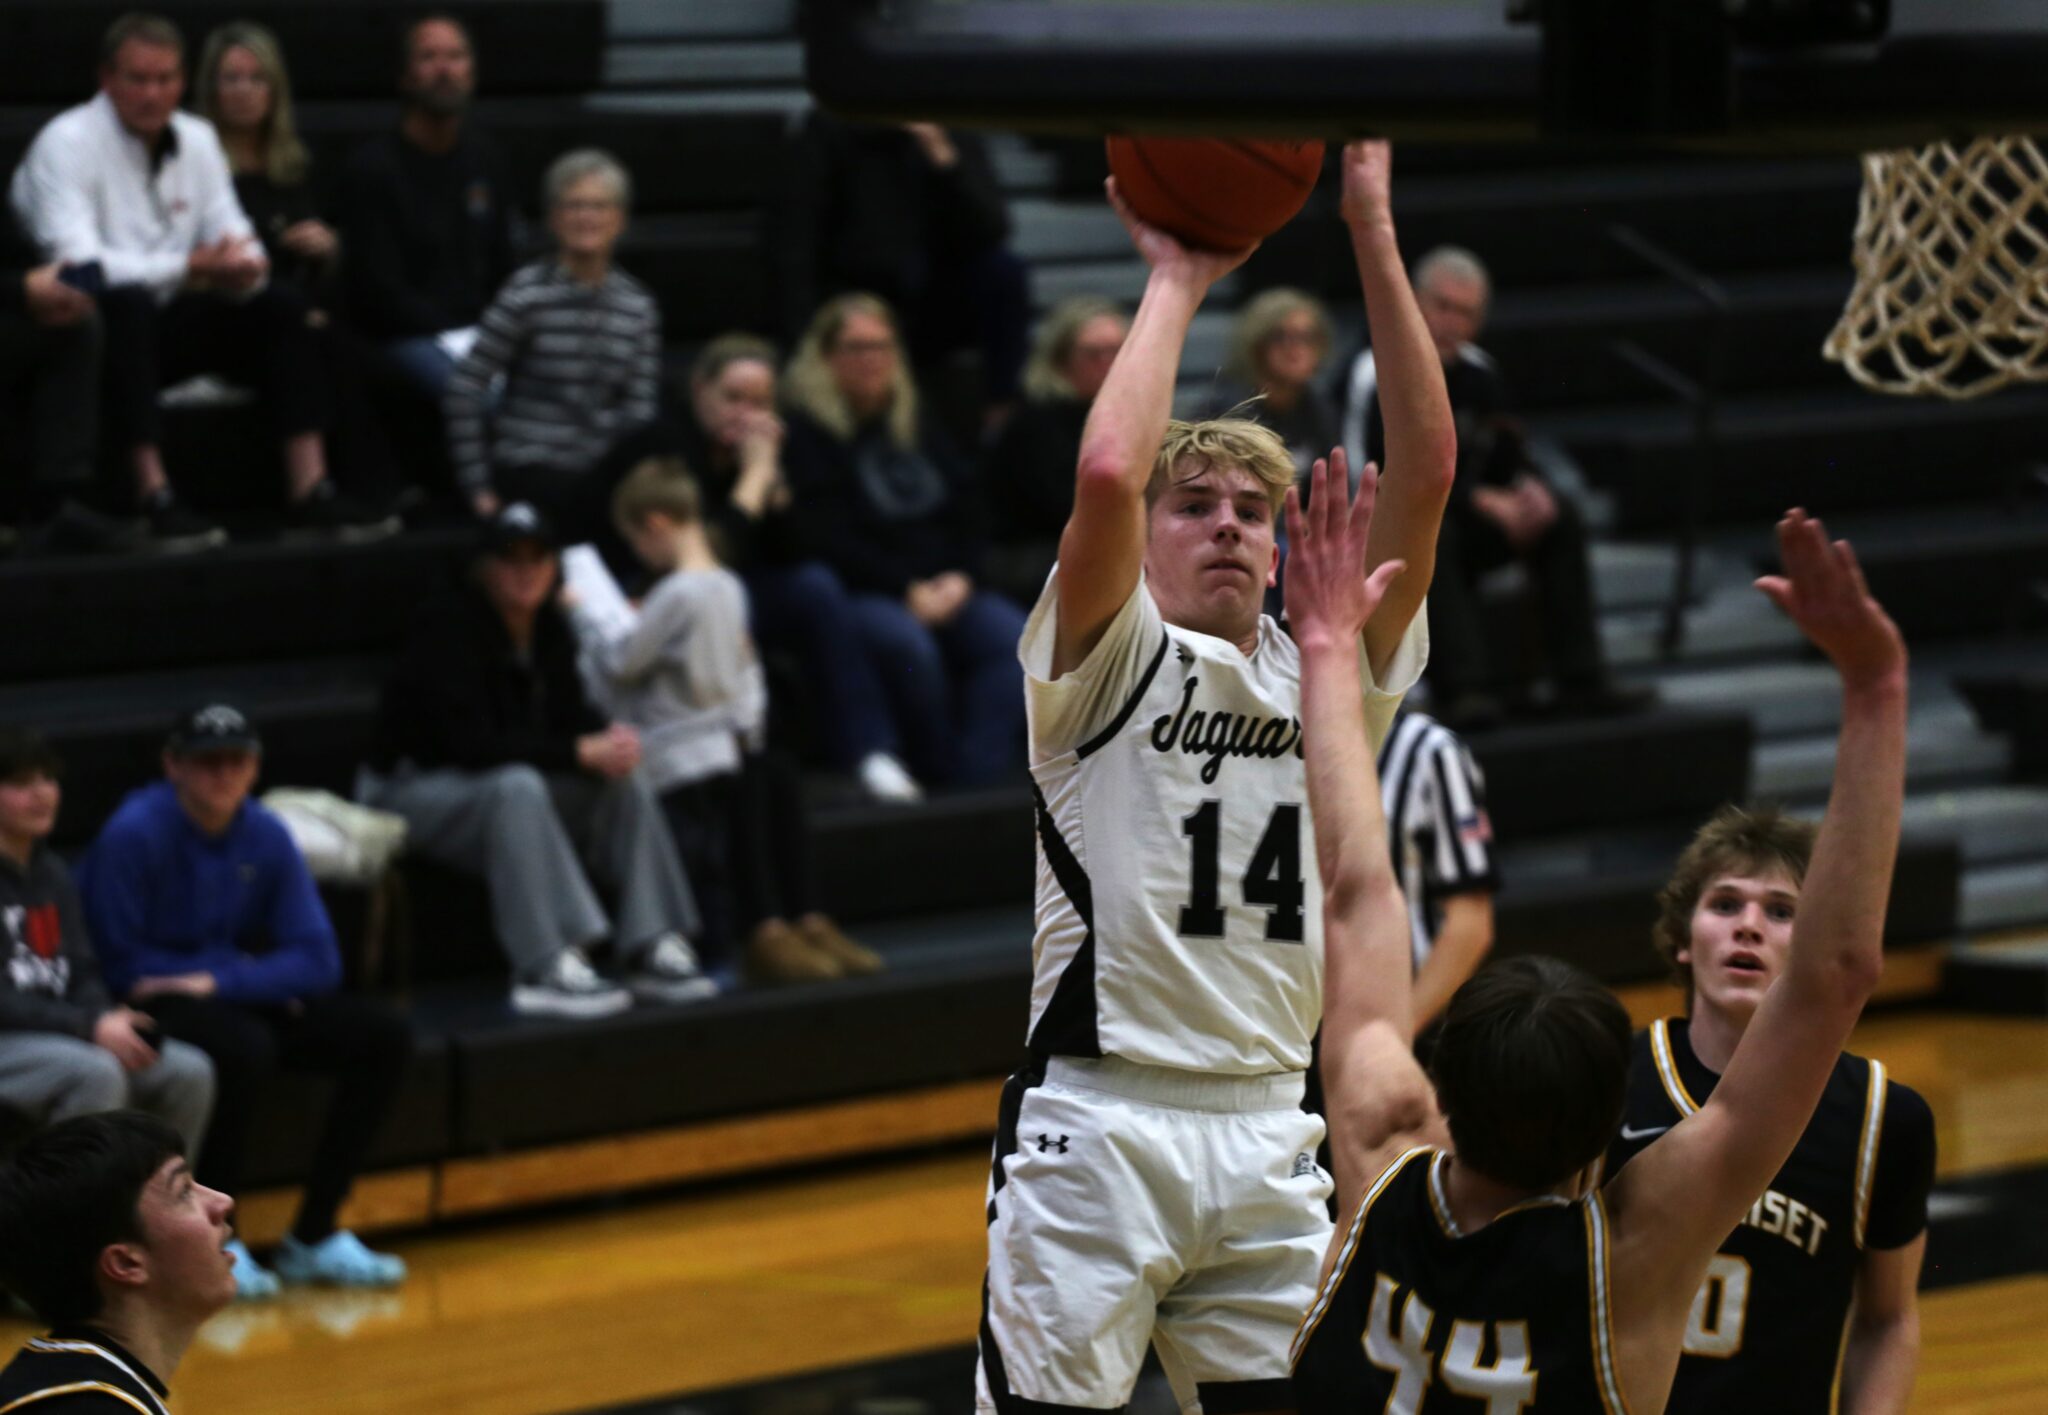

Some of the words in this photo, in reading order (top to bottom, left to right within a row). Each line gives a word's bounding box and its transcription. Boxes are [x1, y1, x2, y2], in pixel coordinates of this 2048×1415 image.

[1177, 799, 1305, 945] 14
[1360, 1269, 1540, 1415] 44
[1682, 1252, 1754, 1360] 0
